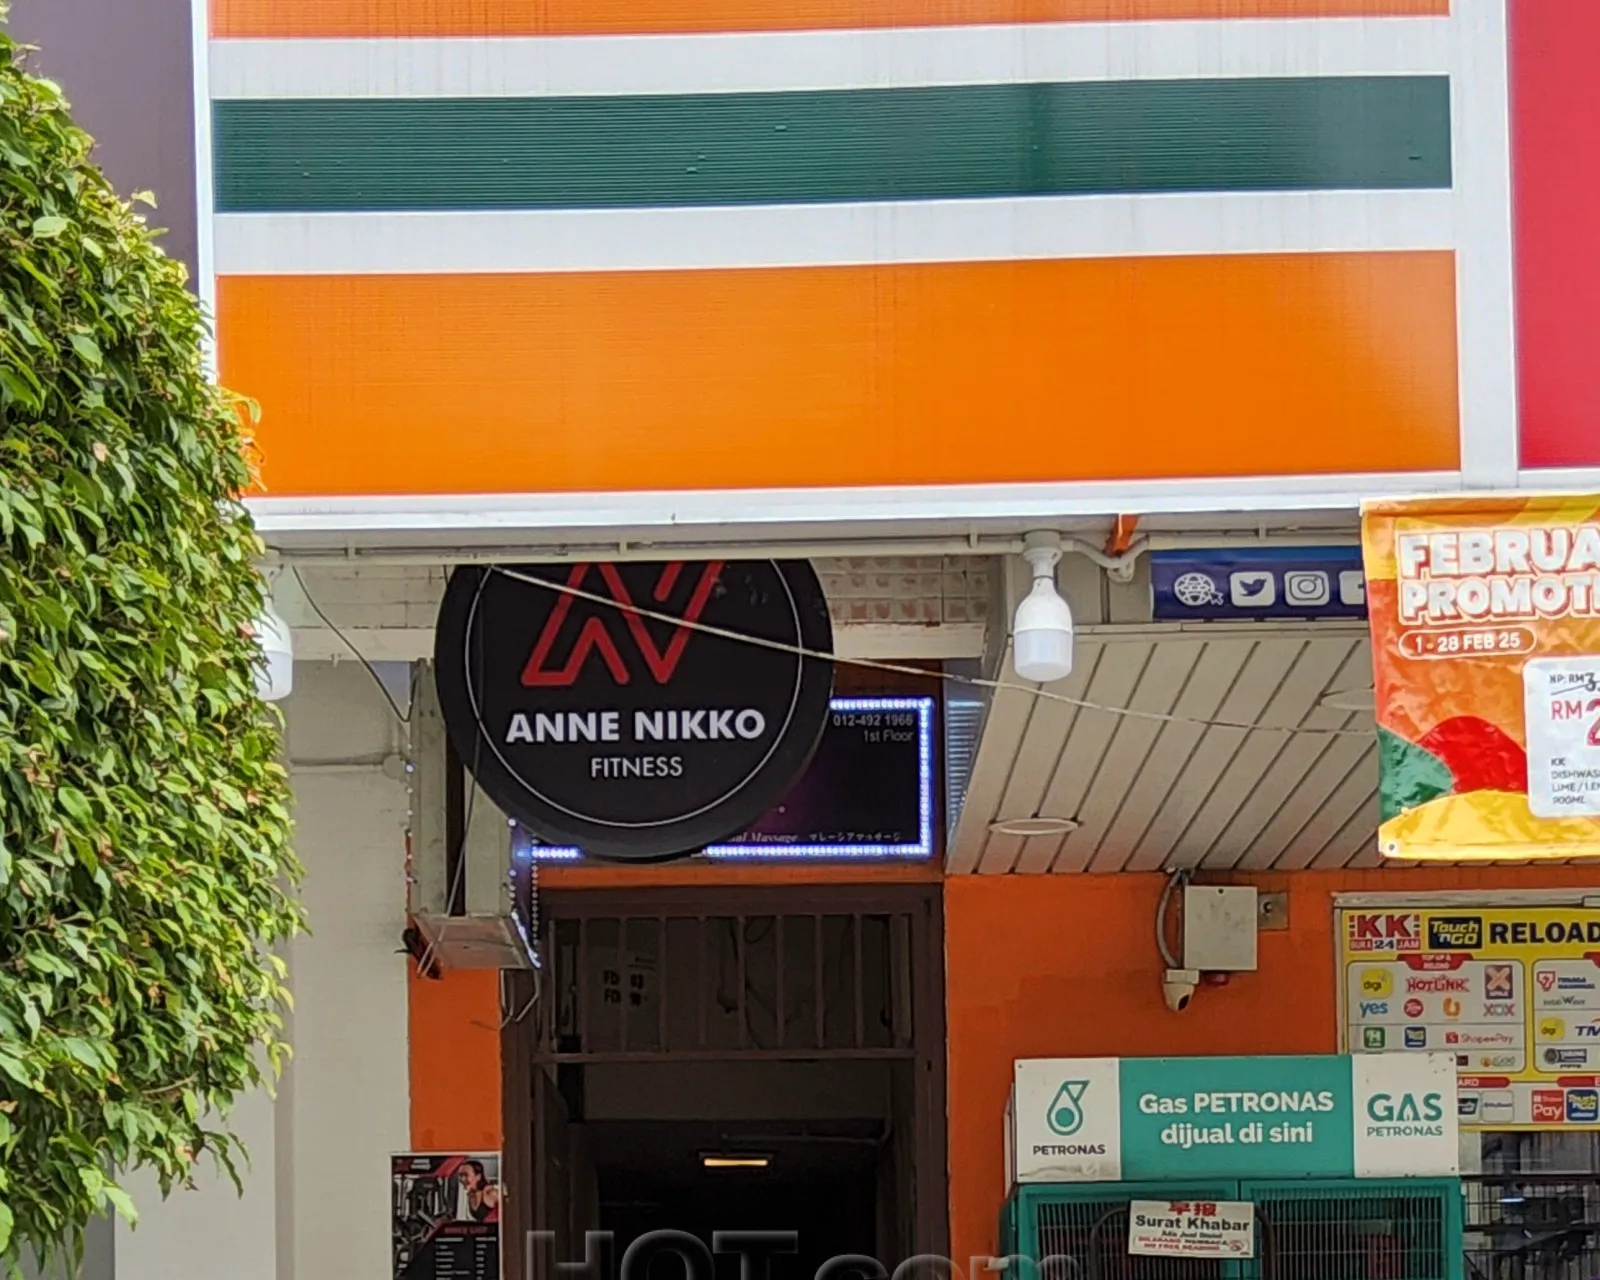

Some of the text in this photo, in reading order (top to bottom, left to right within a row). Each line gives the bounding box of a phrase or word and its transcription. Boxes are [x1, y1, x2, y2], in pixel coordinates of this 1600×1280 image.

[1437, 634, 1459, 653] 28
[1463, 633, 1495, 652] FEB
[1499, 631, 1521, 649] 25
[506, 709, 765, 743] ANNE NIKKO
[833, 714, 881, 727] 012-492
[863, 729, 914, 743] 1st Floor
[591, 757, 683, 778] FITNESS
[1356, 913, 1413, 938] KK
[1431, 919, 1479, 934] Touch
[1489, 921, 1600, 944] RELOAD
[1374, 940, 1394, 949] 24
[1397, 939, 1420, 949] JAM
[1360, 1001, 1388, 1018] yes
[1483, 1003, 1515, 1017] XOX
[1139, 1092, 1334, 1115] Gas PETRONAS
[1367, 1092, 1442, 1122] GAS
[1533, 1104, 1562, 1119] Pay
[1161, 1121, 1313, 1150] dijual di sini
[1367, 1125, 1443, 1137] PETRONAS
[1033, 1144, 1106, 1156] PETRONAS
[1135, 1215, 1250, 1231] Surat Khabar
